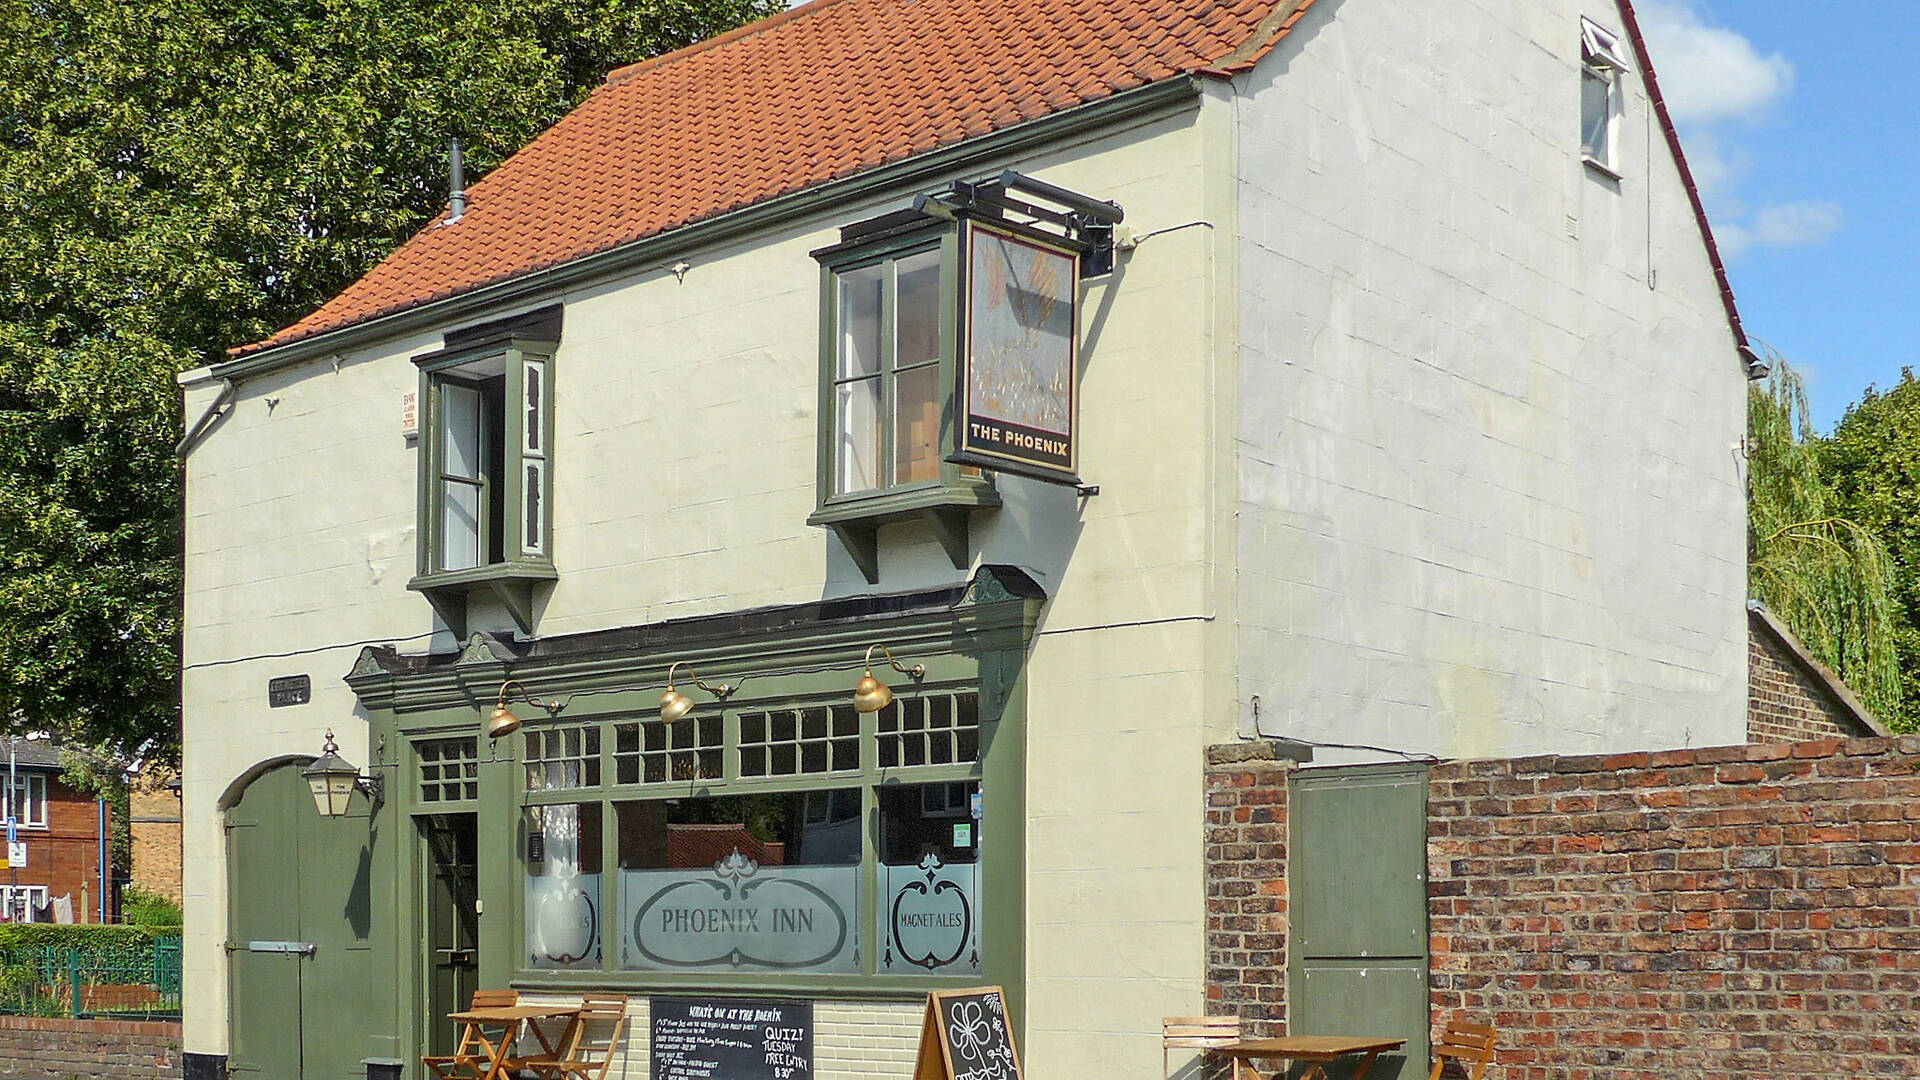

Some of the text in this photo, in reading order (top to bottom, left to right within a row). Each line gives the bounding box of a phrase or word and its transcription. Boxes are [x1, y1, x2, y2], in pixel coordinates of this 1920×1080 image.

[971, 423, 1067, 456] THE PHOENIX
[662, 908, 813, 933] PHOENIX INN
[901, 912, 962, 928] MAGNET ALES
[727, 1009, 738, 1020] AT
[739, 1009, 753, 1021] THE
[765, 1027, 804, 1041] QUIZ!
[762, 1040, 796, 1053] TUESDAY
[765, 1053, 808, 1071] FREE ENTRY
